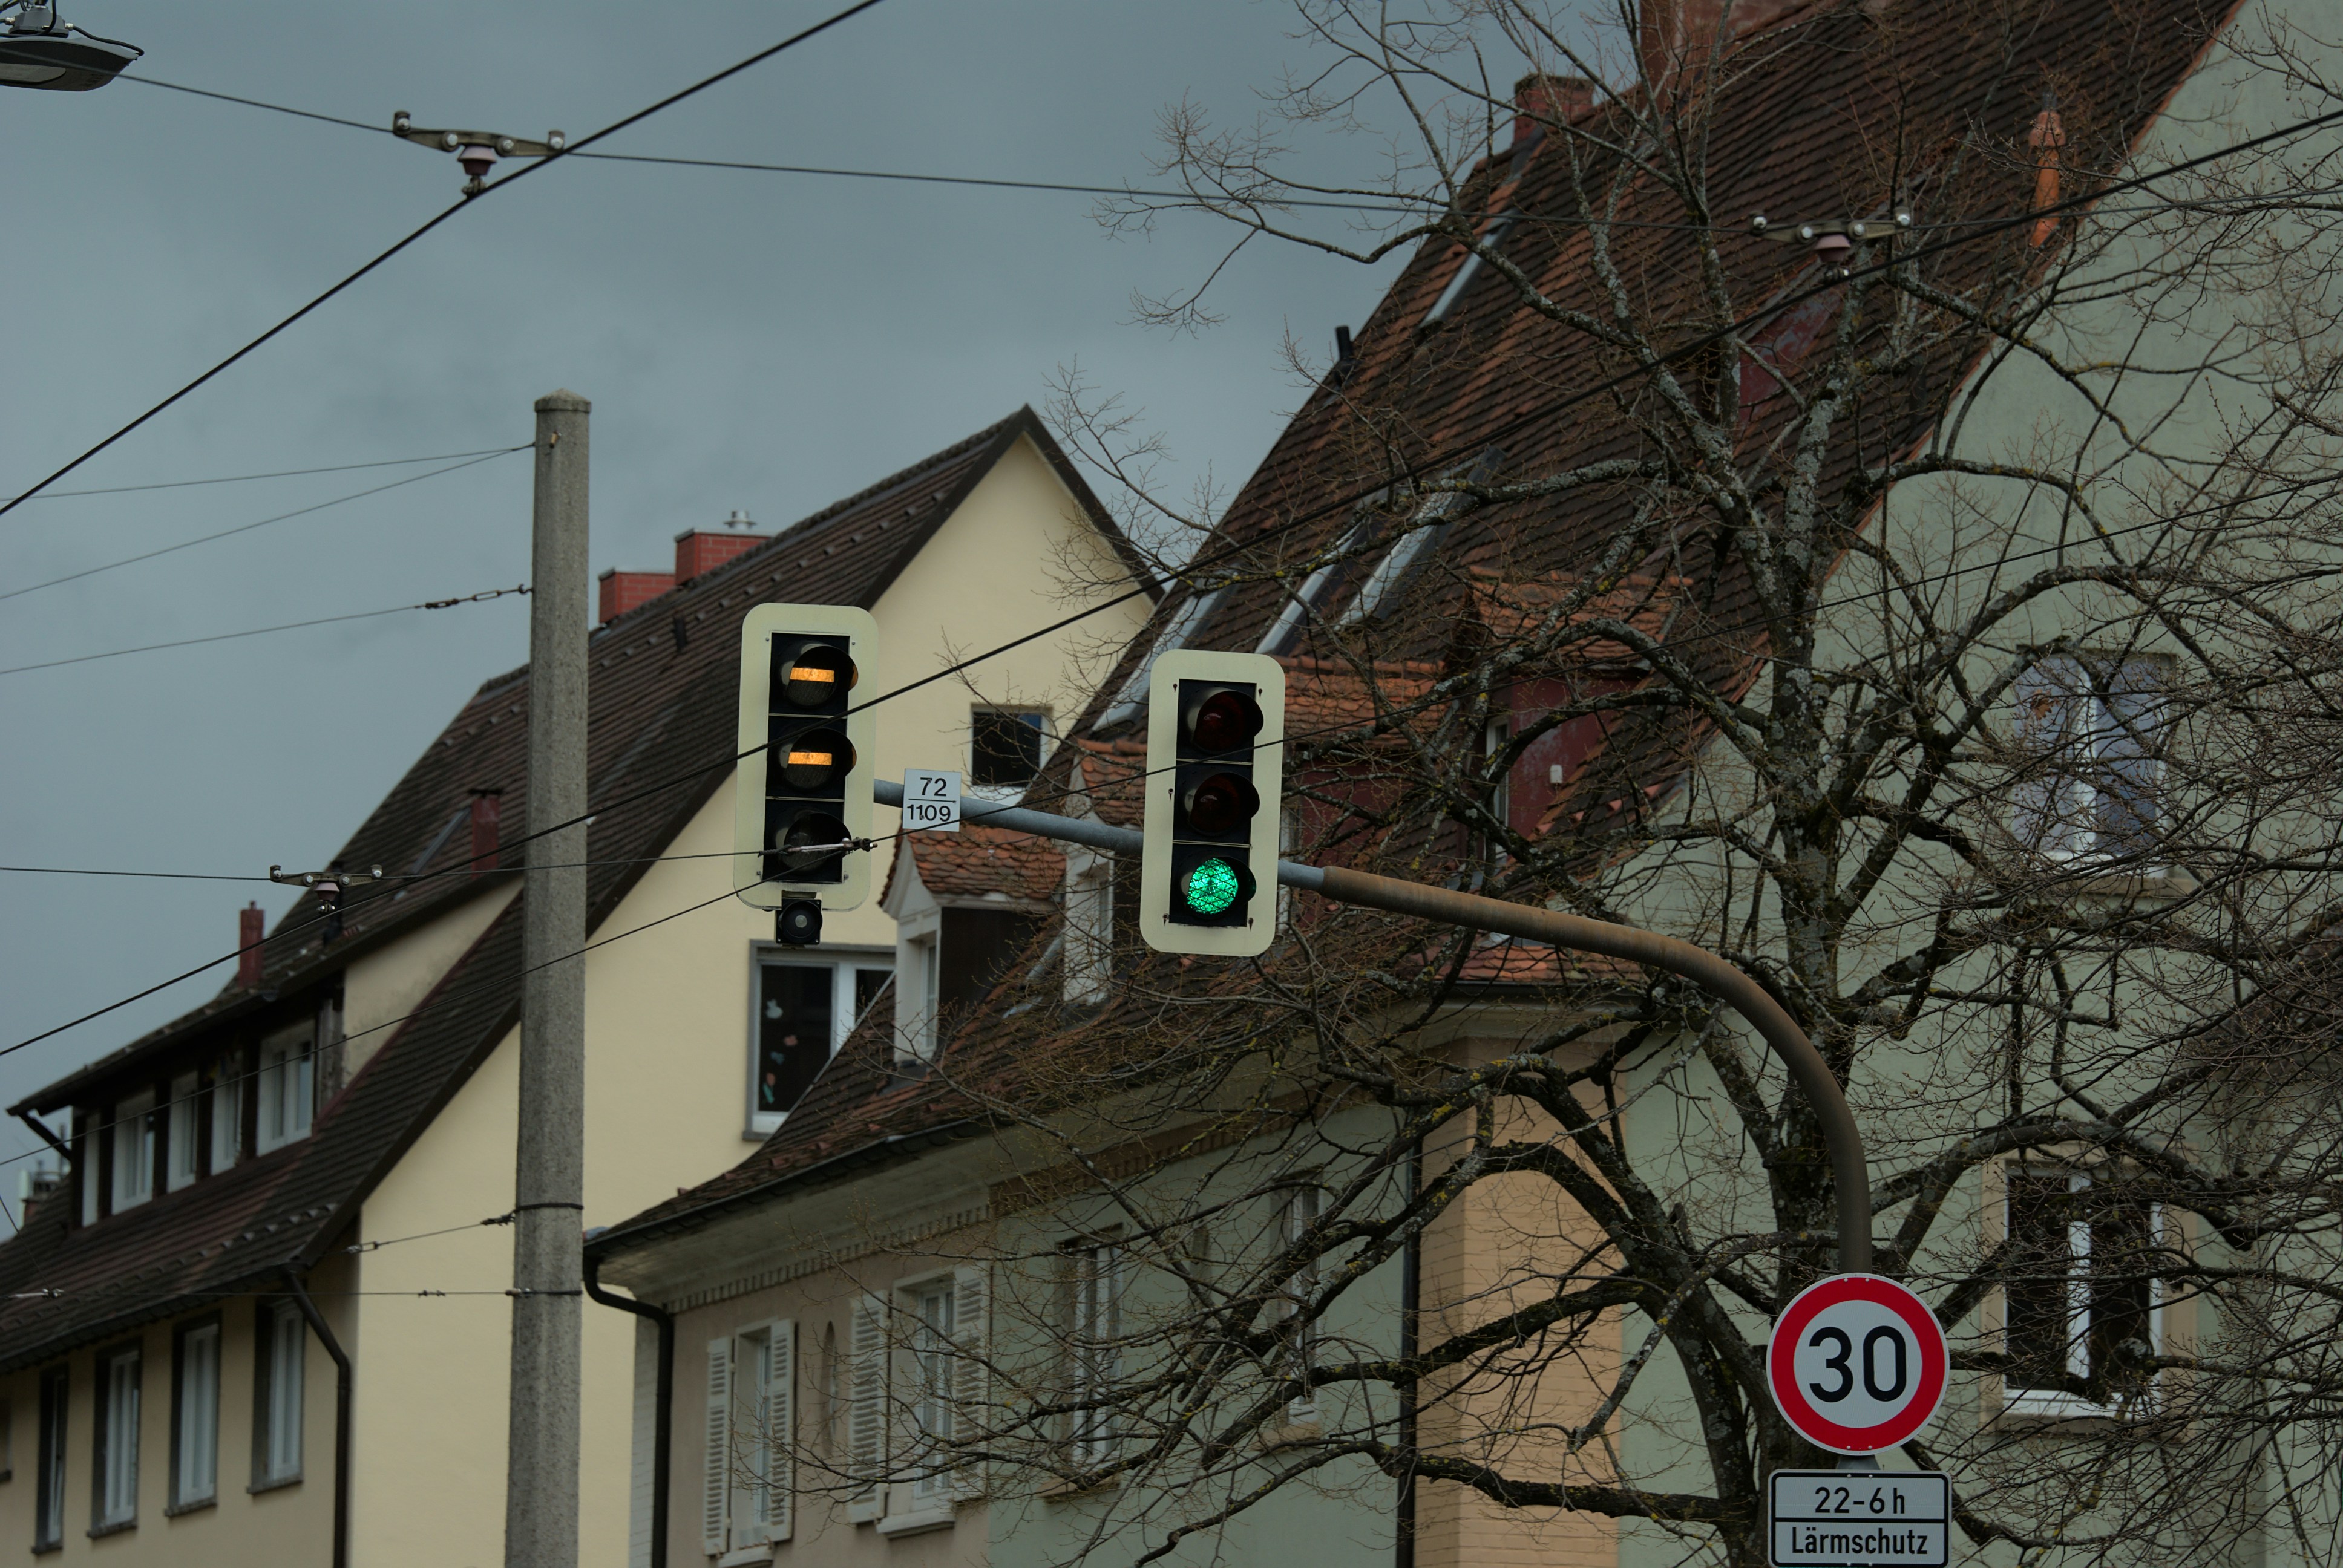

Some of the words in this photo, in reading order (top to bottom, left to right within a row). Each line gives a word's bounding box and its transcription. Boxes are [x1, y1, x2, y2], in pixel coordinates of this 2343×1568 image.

[920, 777, 947, 797] 72
[906, 804, 951, 822] 1109
[1809, 1325, 1907, 1403] 30
[1792, 1526, 1928, 1555] Lärmschutz
